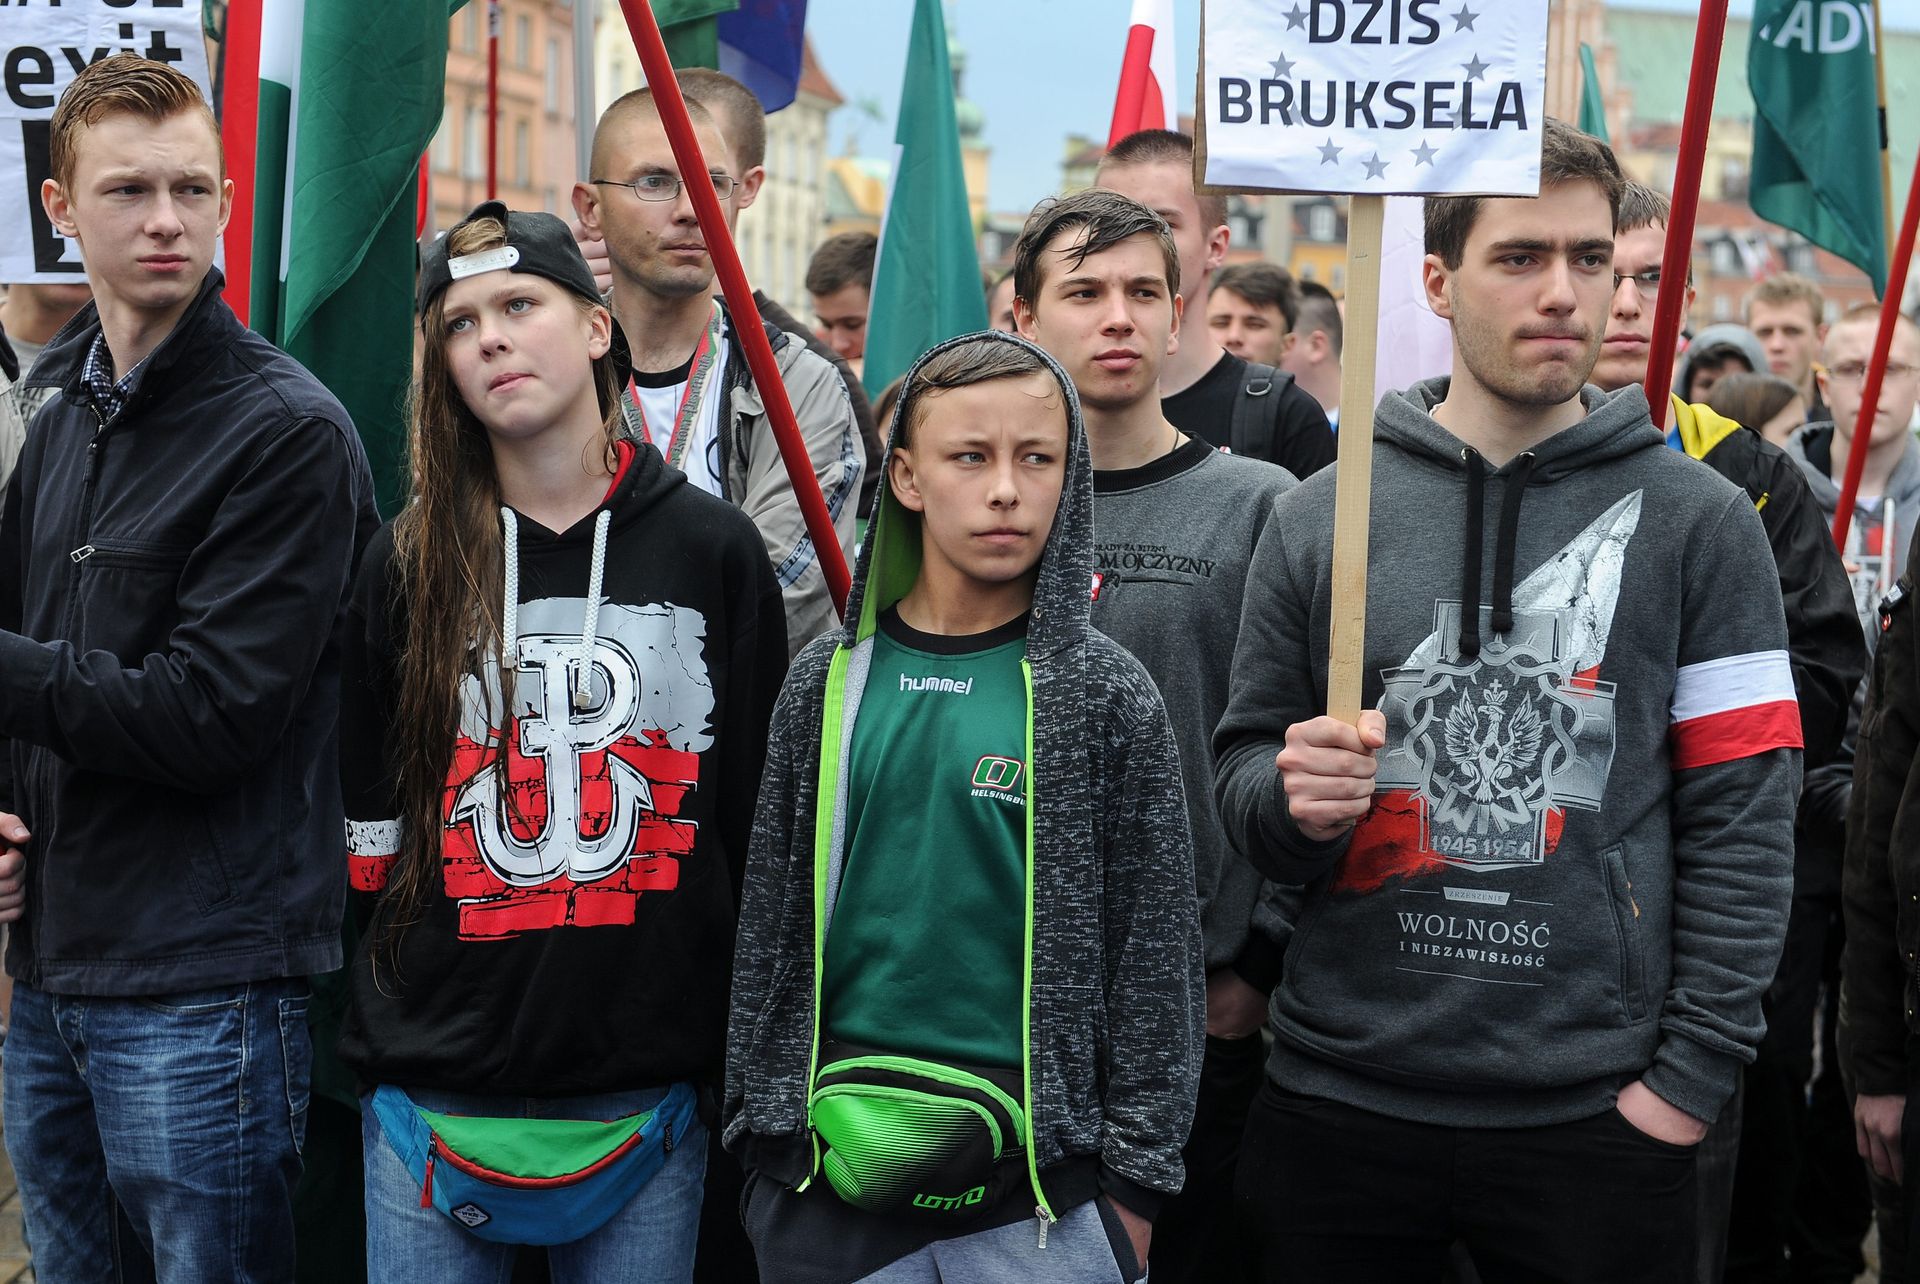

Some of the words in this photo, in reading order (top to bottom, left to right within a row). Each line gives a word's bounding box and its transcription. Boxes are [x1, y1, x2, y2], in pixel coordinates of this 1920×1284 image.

[1219, 77, 1528, 131] BRUKSELA
[1122, 552, 1217, 578] OJCZYZNY
[900, 673, 973, 695] hummel
[1432, 835, 1478, 855] 1945
[1484, 837, 1531, 859] 1954
[1397, 911, 1550, 949] WOLNOŚĆ
[1400, 941, 1405, 951] I
[1411, 942, 1545, 967] NIEZAWISŁOŚĆ
[912, 1186, 986, 1211] LOTTO
